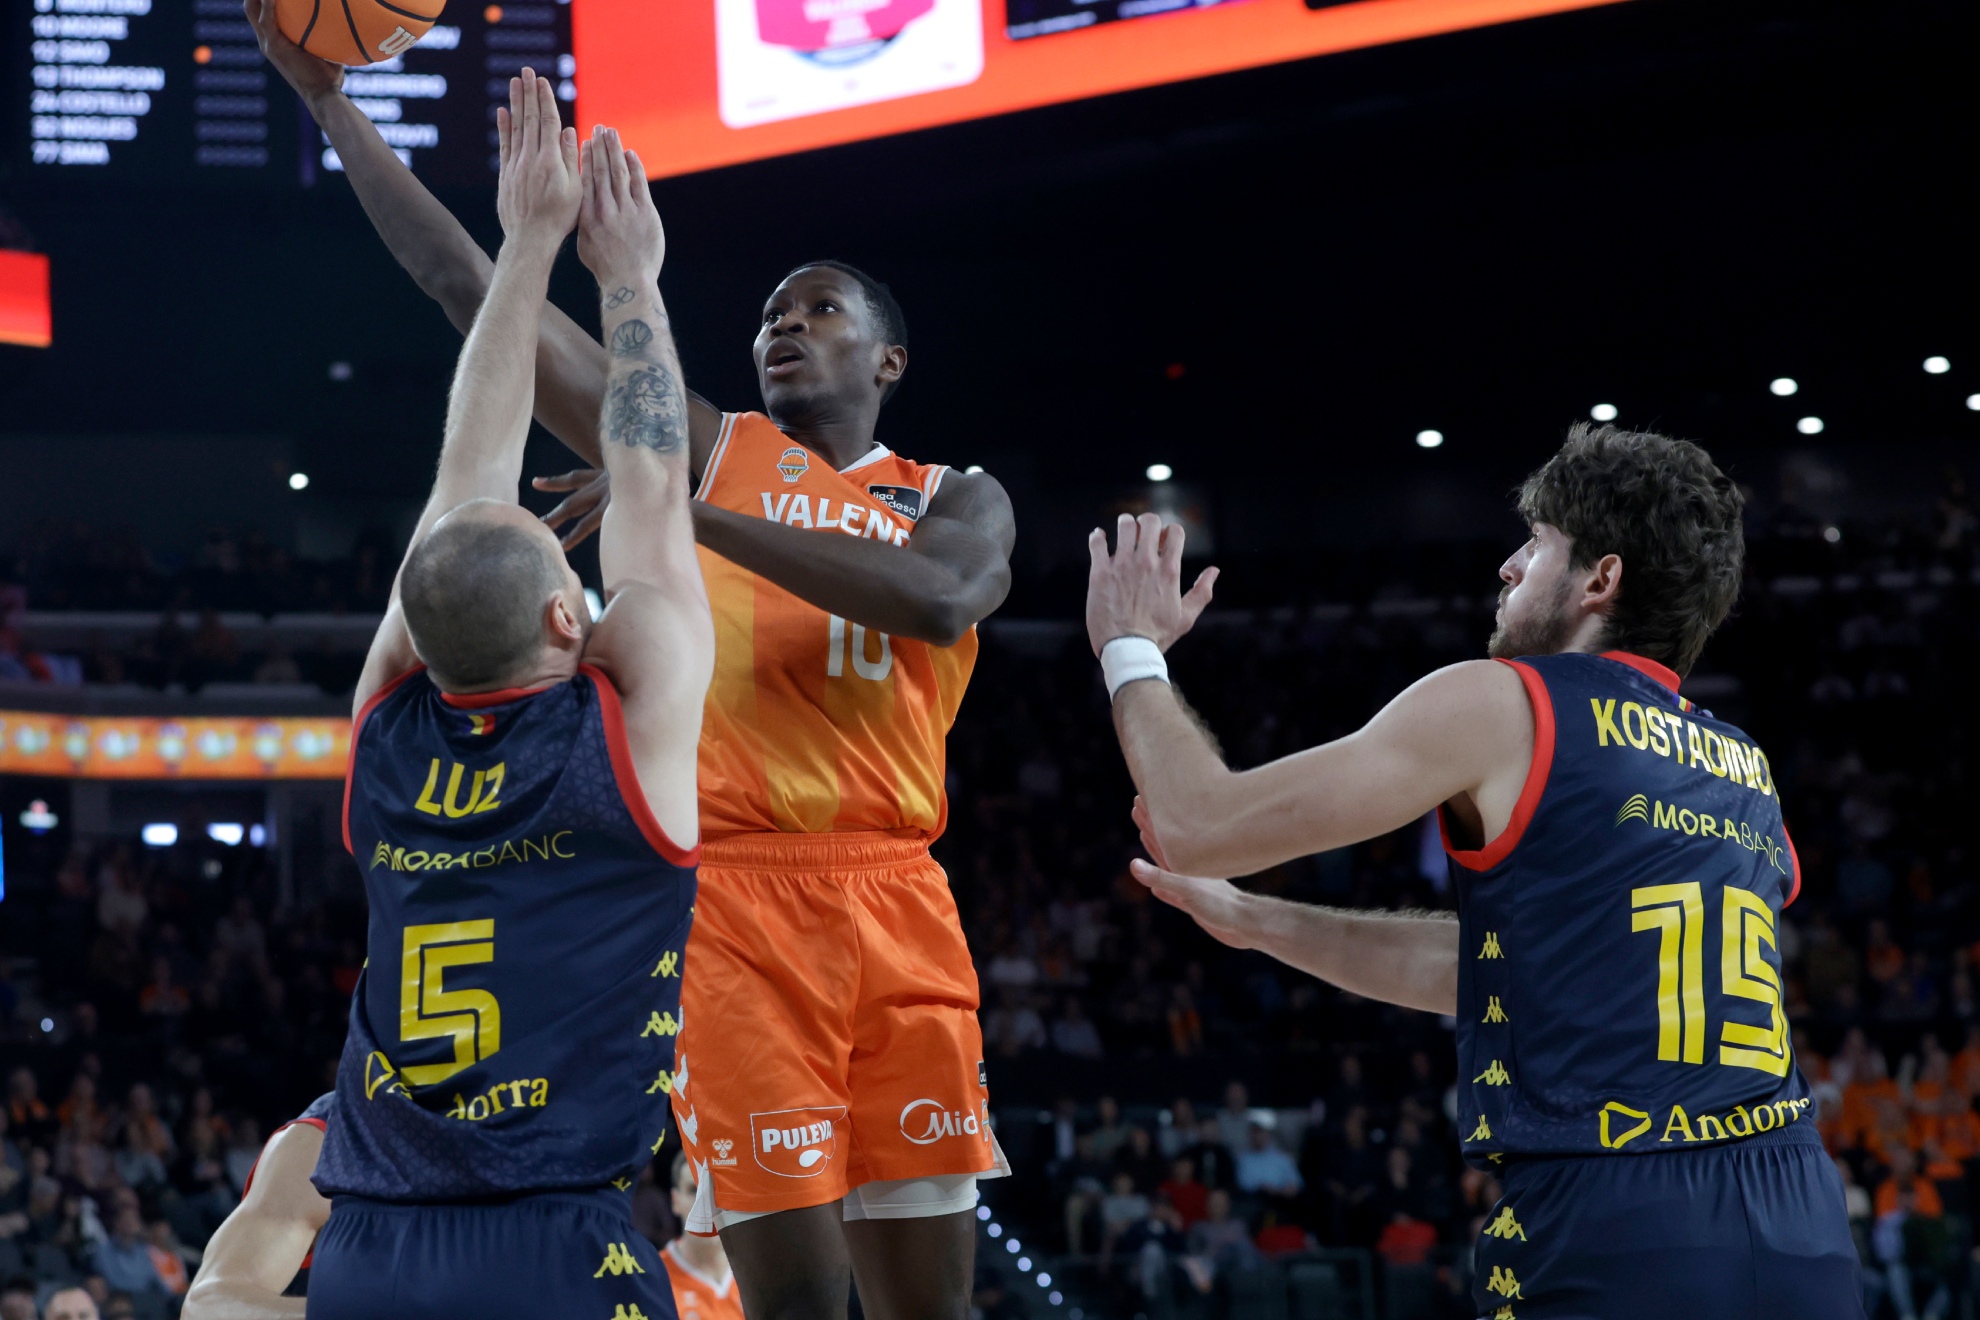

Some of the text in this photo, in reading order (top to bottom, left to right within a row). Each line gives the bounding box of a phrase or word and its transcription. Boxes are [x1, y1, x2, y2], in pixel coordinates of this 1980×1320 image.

[415, 758, 506, 818] LUZ
[1590, 698, 1779, 804] KOSTADINO
[389, 831, 576, 871] MORABANC
[1653, 800, 1786, 874] MORABANC
[400, 918, 500, 1086] 5
[1632, 881, 1790, 1078] 15
[761, 1119, 832, 1153] PULEVA
